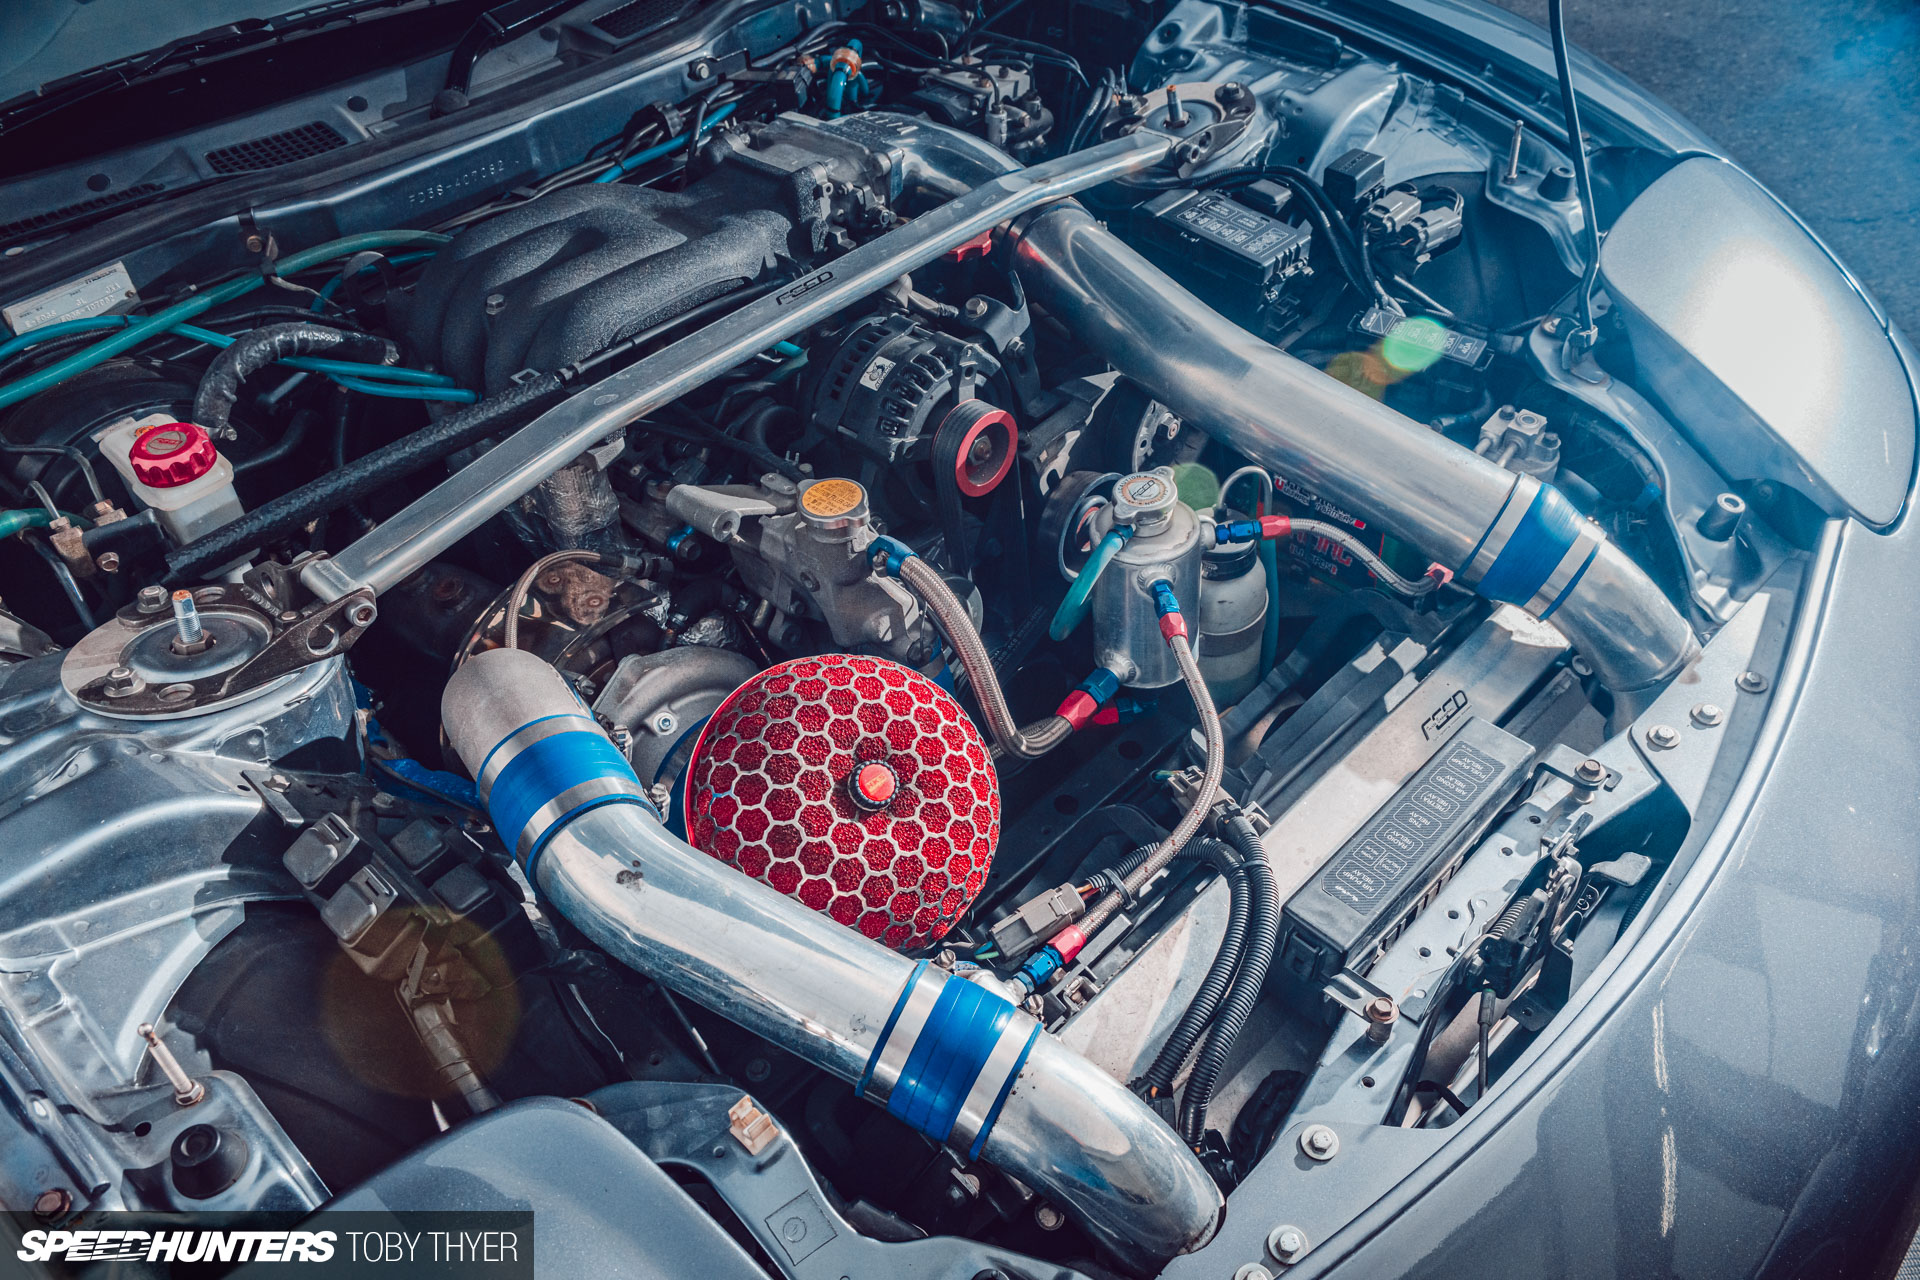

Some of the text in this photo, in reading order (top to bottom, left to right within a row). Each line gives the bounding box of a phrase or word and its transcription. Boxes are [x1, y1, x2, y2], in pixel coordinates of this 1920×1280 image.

[776, 271, 834, 305] FEED
[1131, 479, 1156, 500] FEED
[1421, 690, 1468, 741] FEED
[1462, 757, 1483, 770] RELAY
[1436, 776, 1468, 796] AIR COND
[1445, 775, 1466, 788] RELAY
[1409, 811, 1431, 826] RELAY
[1409, 817, 1422, 828] TNS
[1342, 871, 1375, 892] AIR PUMP
[1353, 869, 1374, 884] RELAY
